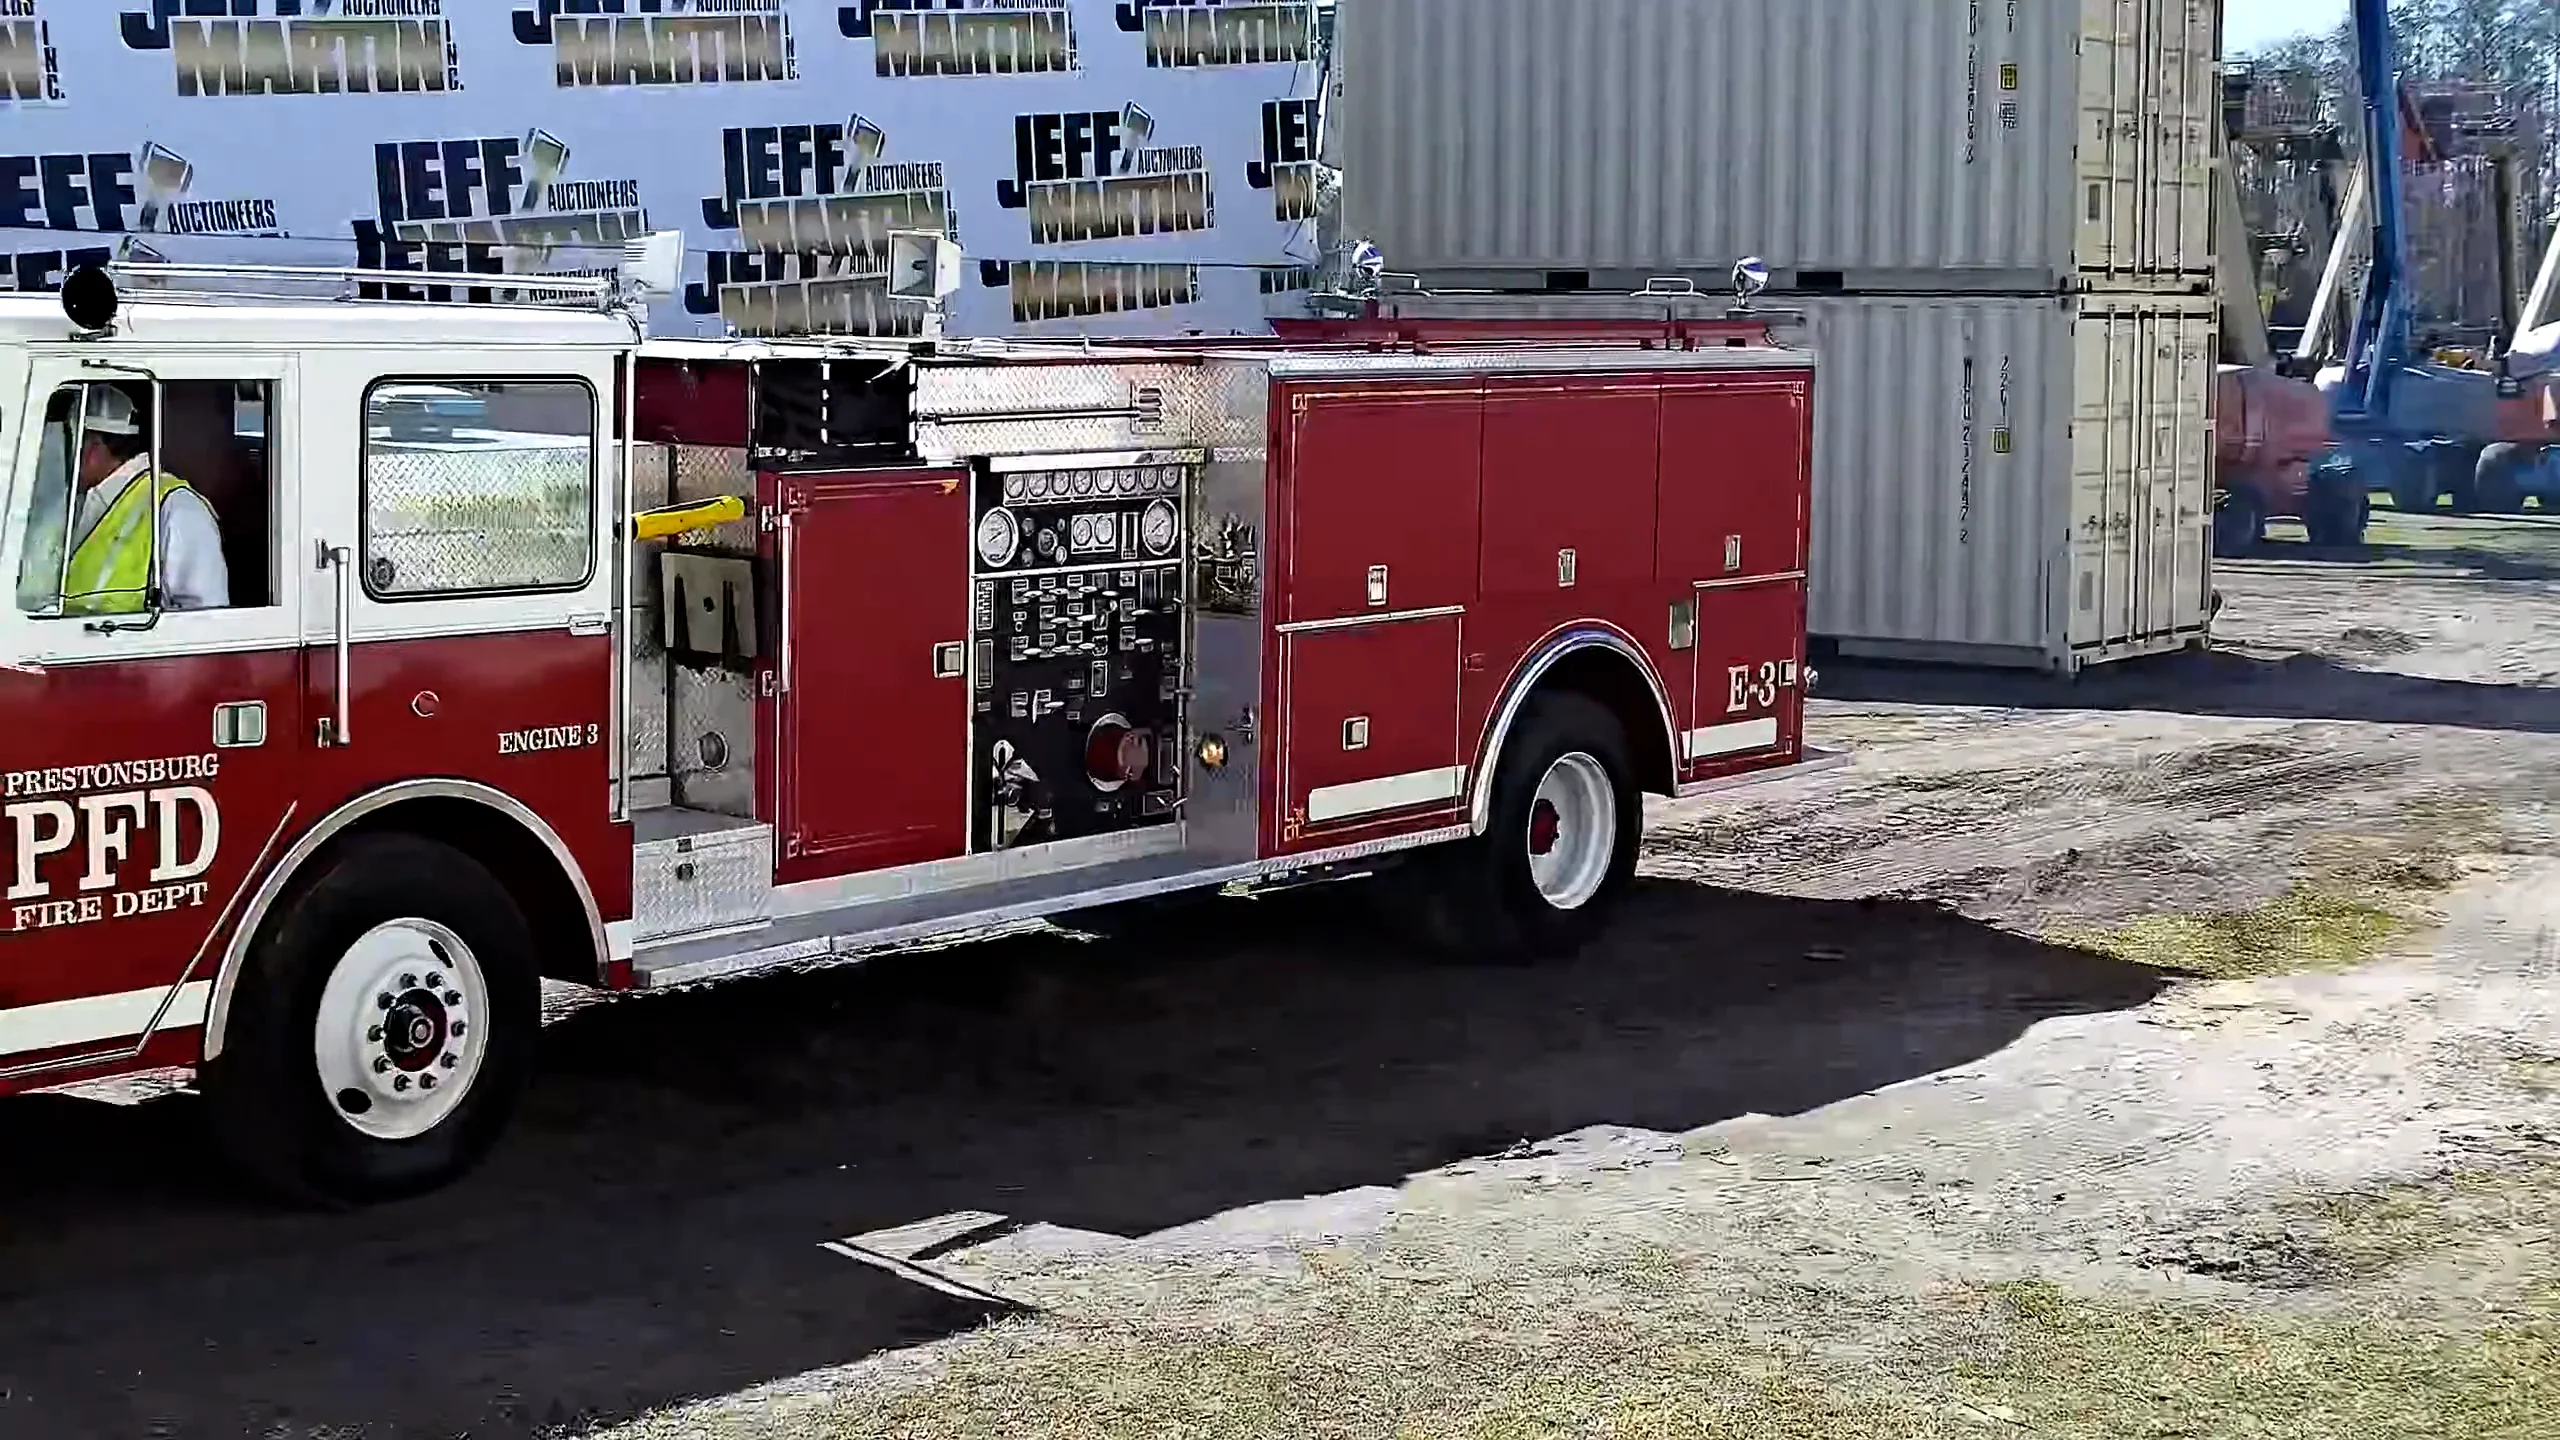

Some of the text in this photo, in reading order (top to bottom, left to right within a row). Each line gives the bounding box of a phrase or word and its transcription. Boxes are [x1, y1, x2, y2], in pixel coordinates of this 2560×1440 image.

[701, 123, 845, 229] JEFF
[864, 161, 944, 192] AUCTIONEERS
[997, 111, 1121, 209] JEFF
[1137, 147, 1203, 175] AUCTIONEERS
[352, 137, 524, 243] JEFF
[547, 179, 639, 212] AUCTIONEERS
[167, 199, 278, 233] AUCTIONEERS
[1727, 661, 1776, 713] E-3
[498, 723, 599, 754] ENGINE 3
[5, 753, 220, 797] PRESTONSBURG
[5, 786, 220, 900] PFD
[12, 882, 208, 932] FIRE DEPT
